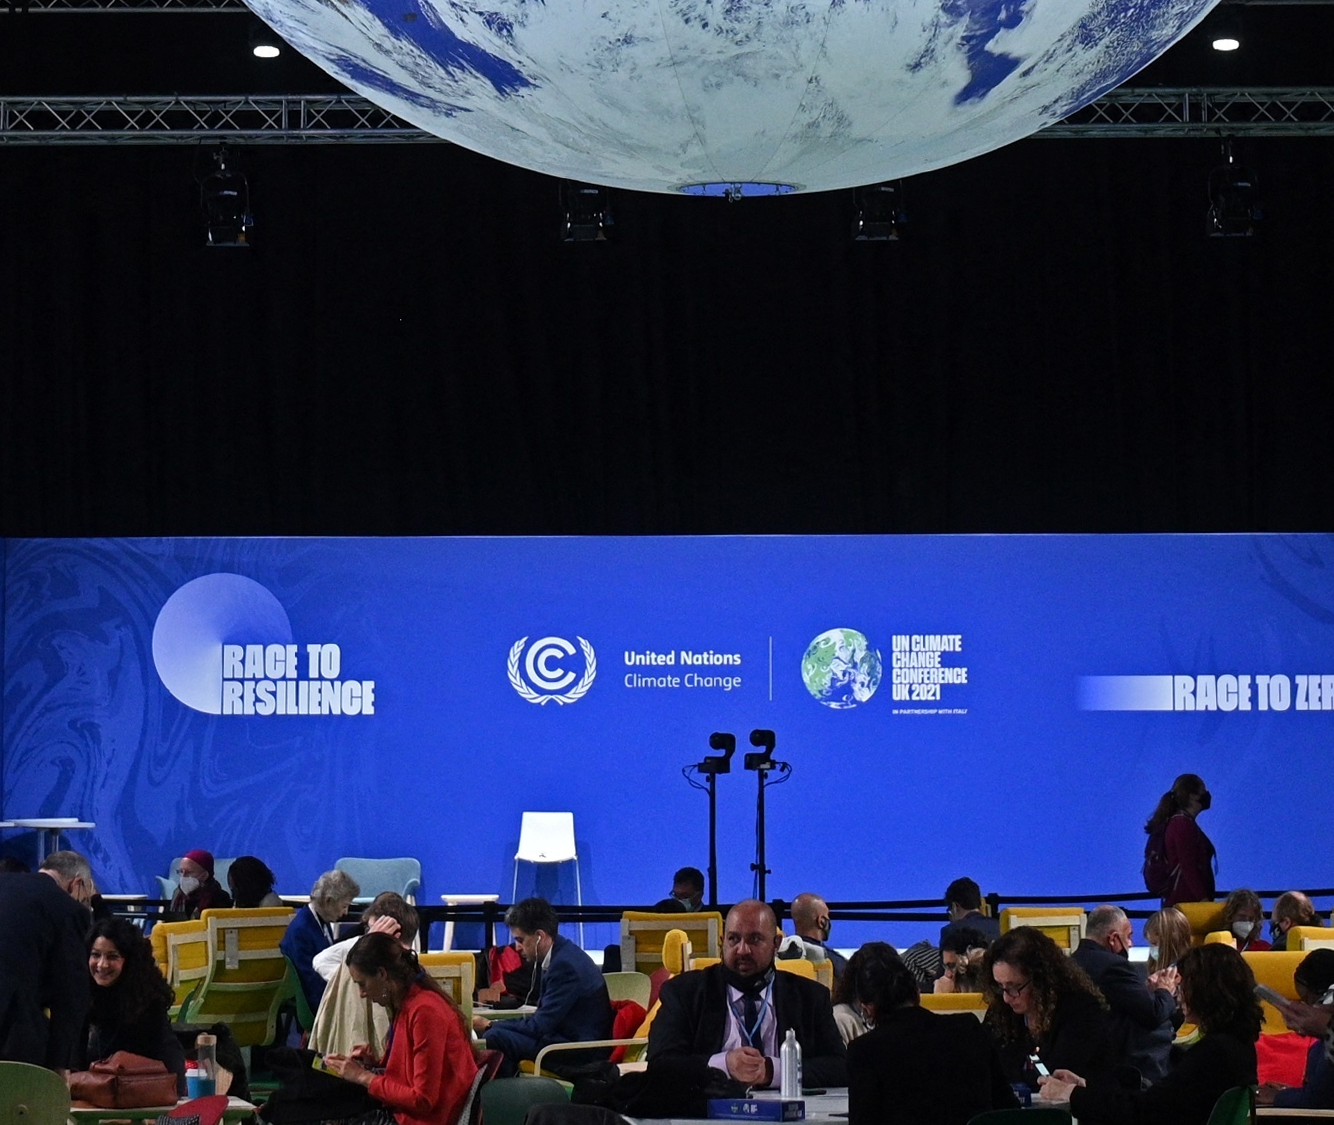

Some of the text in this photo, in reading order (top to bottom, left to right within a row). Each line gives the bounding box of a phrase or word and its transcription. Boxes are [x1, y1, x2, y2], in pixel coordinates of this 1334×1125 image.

[892, 635, 962, 651] UN CLIMATE
[223, 643, 341, 679] RACE TO
[624, 650, 742, 666] United Nations
[892, 651, 941, 668] CHANGE
[624, 672, 742, 692] Climate Change
[892, 667, 968, 684] CONFERENCE
[222, 680, 375, 716] RESILIENCE
[892, 683, 941, 701] UK 2021
[1174, 674, 1251, 711] RACE
[1256, 674, 1291, 711] TO
